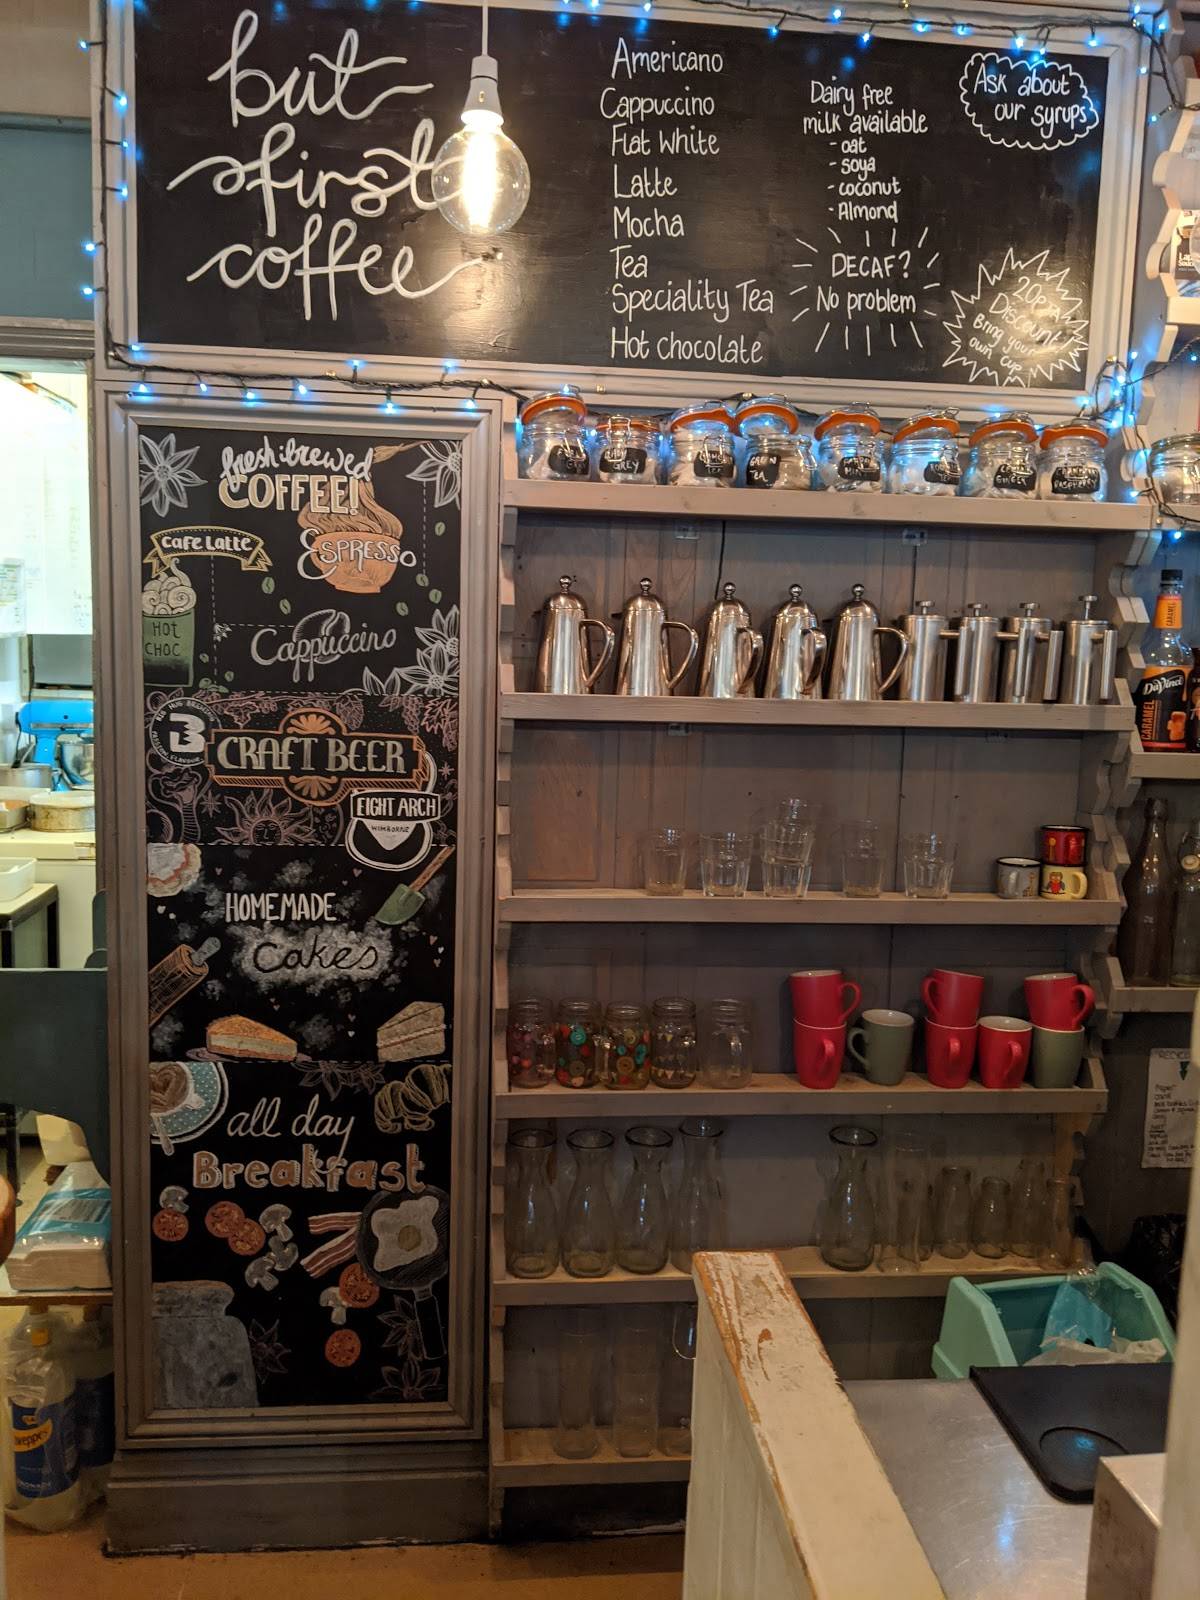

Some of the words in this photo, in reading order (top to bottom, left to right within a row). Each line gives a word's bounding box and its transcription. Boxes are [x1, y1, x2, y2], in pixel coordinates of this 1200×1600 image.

[208, 9, 434, 128] but
[611, 37, 723, 79] Americano
[810, 76, 855, 116] Dairy
[862, 83, 893, 110] free
[974, 63, 1007, 94] Ask
[1018, 69, 1070, 95] about
[600, 86, 715, 124] Cappuccino
[803, 110, 841, 135] milk
[849, 109, 929, 134] available
[995, 103, 1025, 121] our
[1031, 103, 1087, 138] syrups
[611, 123, 651, 157] Flat
[166, 118, 472, 237] first
[613, 163, 678, 199] Latte
[613, 205, 685, 240] Mocha
[186, 213, 484, 320] coffee
[609, 244, 648, 280] Tea
[831, 250, 911, 279] DECAF?
[612, 278, 729, 323] Speciality
[735, 279, 774, 314] Tea
[817, 285, 839, 312] No
[848, 285, 916, 319] problem
[973, 313, 1004, 347] Bring
[989, 293, 1062, 346] Discount
[611, 326, 650, 359] Hot
[969, 337, 993, 360] own
[220, 435, 279, 493] fresh
[613, 461, 640, 474] GREY
[219, 473, 359, 516] COFFEE!
[205, 536, 253, 551] Latte
[145, 642, 181, 657] CHOC
[250, 621, 397, 682] Cappuccino
[1143, 675, 1185, 695] DaVinci
[1141, 699, 1155, 740] CARAMEL
[217, 736, 318, 771] CRAFT
[325, 738, 407, 774] BEER
[356, 797, 396, 817] EIGHT
[397, 797, 436, 817] ARCH
[224, 892, 338, 923] HOMEMADE
[253, 934, 380, 974] Cakes
[227, 1096, 282, 1138] all
[291, 1093, 355, 1172] day
[193, 1143, 426, 1194] Breakfast
